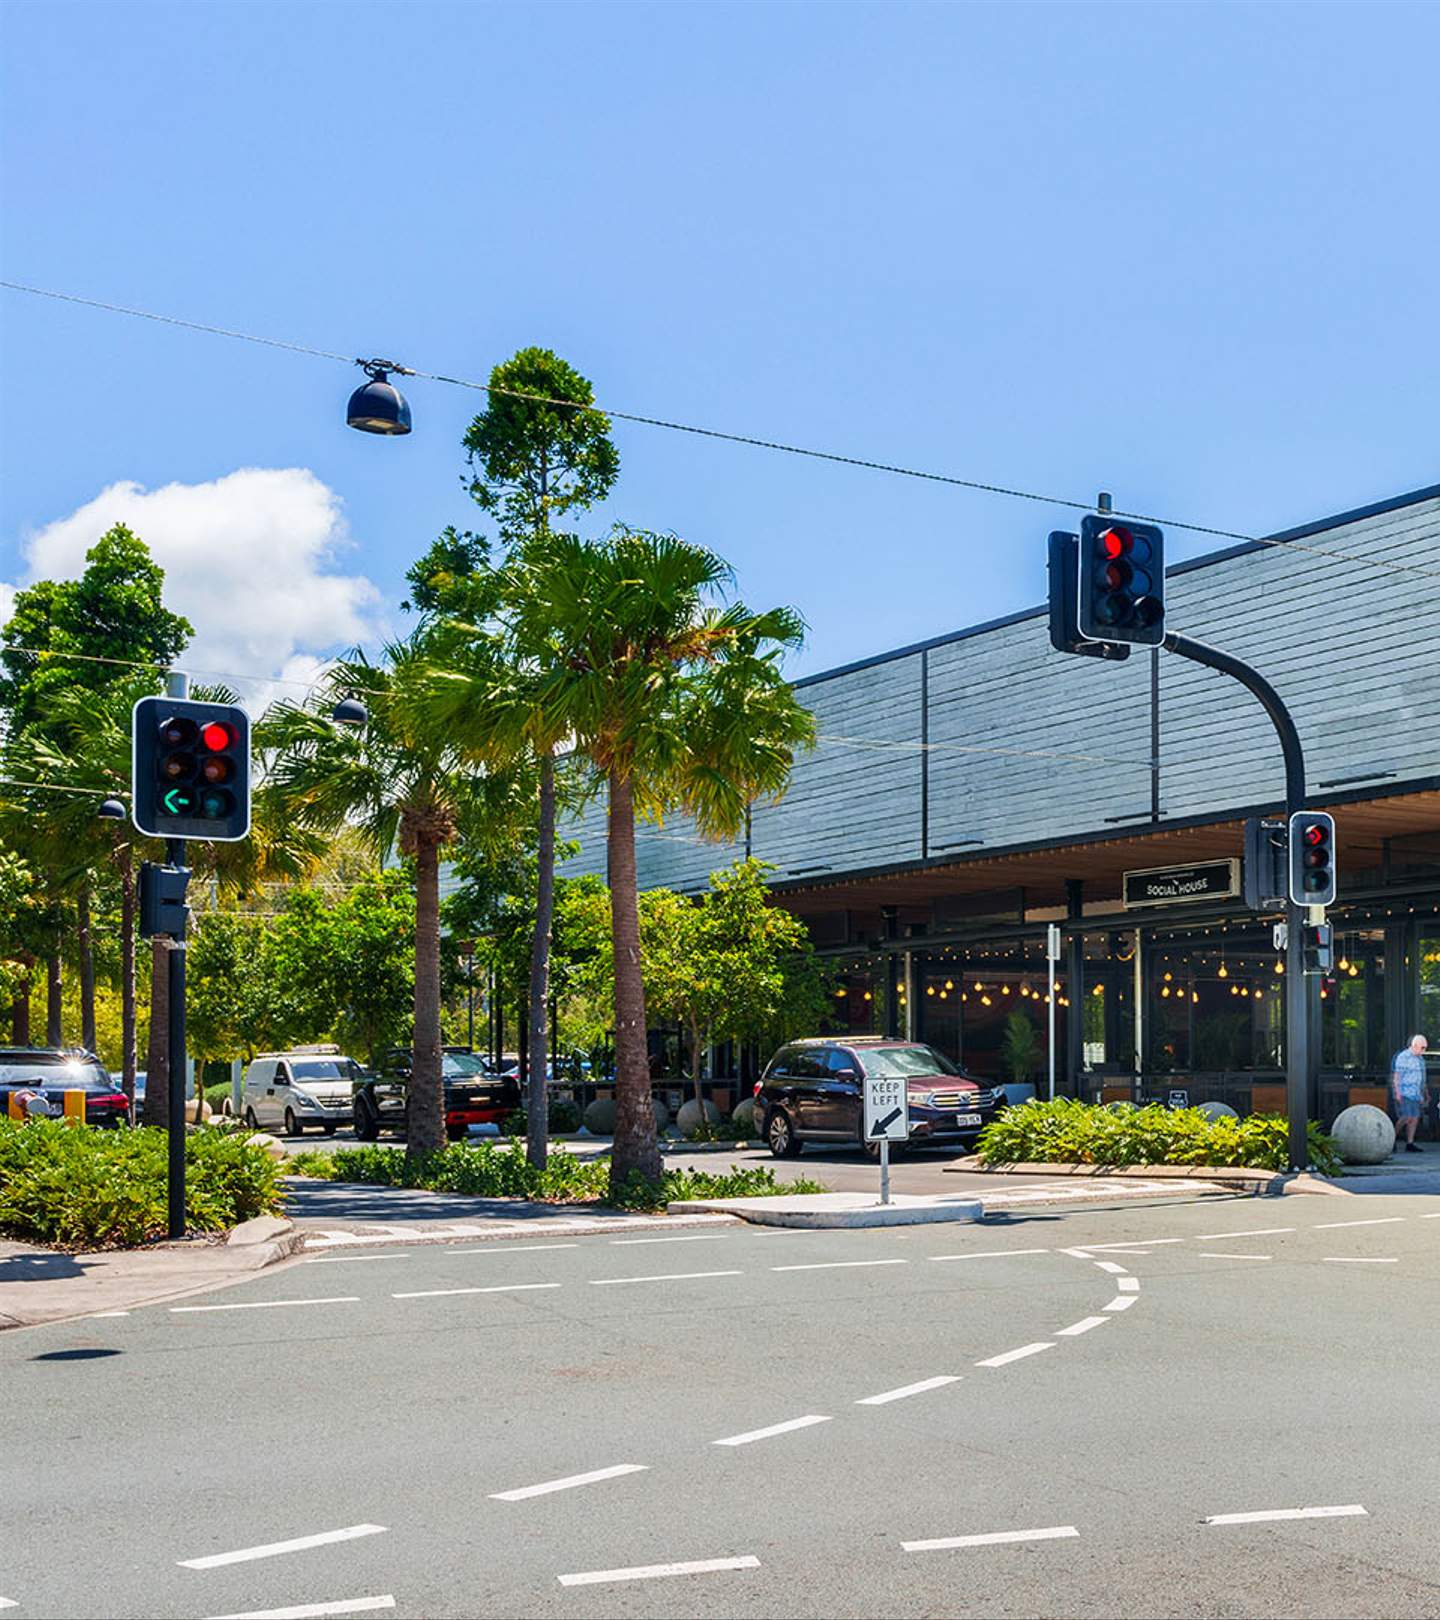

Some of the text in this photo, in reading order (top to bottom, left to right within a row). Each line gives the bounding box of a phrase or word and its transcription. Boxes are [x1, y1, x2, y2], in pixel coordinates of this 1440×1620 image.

[1146, 877, 1209, 896] SOCIAL HOUSE
[872, 1082, 900, 1093] KEEP
[872, 1095, 899, 1106] LEFT
